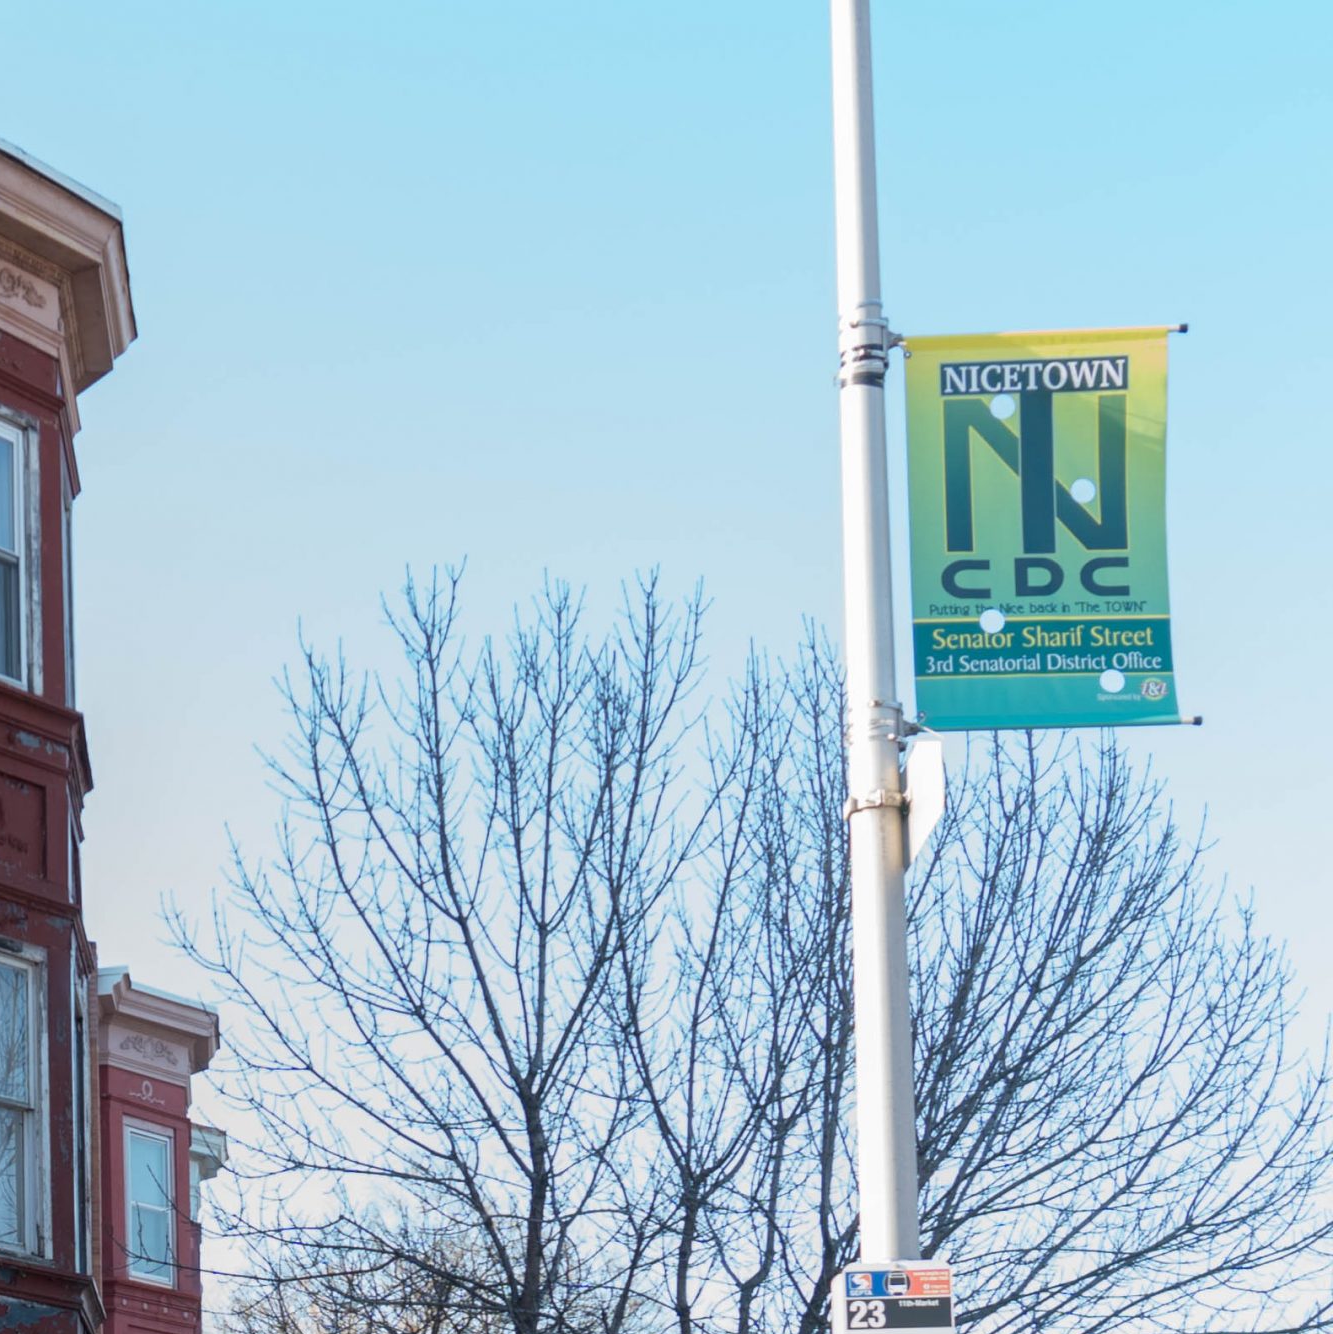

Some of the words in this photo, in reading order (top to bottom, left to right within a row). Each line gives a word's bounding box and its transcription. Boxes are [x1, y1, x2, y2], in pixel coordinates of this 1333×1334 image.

[943, 359, 1125, 395] NICETOWN
[941, 556, 1130, 599] CDC
[929, 602, 970, 617] Putting
[999, 602, 1024, 614] Nice
[1029, 602, 1058, 614] back
[1061, 602, 1071, 613] in
[932, 629, 1014, 650] Senator
[1022, 624, 1083, 648] Sharif
[1091, 625, 1154, 647] Street
[925, 655, 954, 674] 3rd
[958, 652, 1042, 673] Senatorial
[1047, 652, 1106, 671] District
[1112, 651, 1163, 670] Office
[849, 1300, 886, 1328] 23
